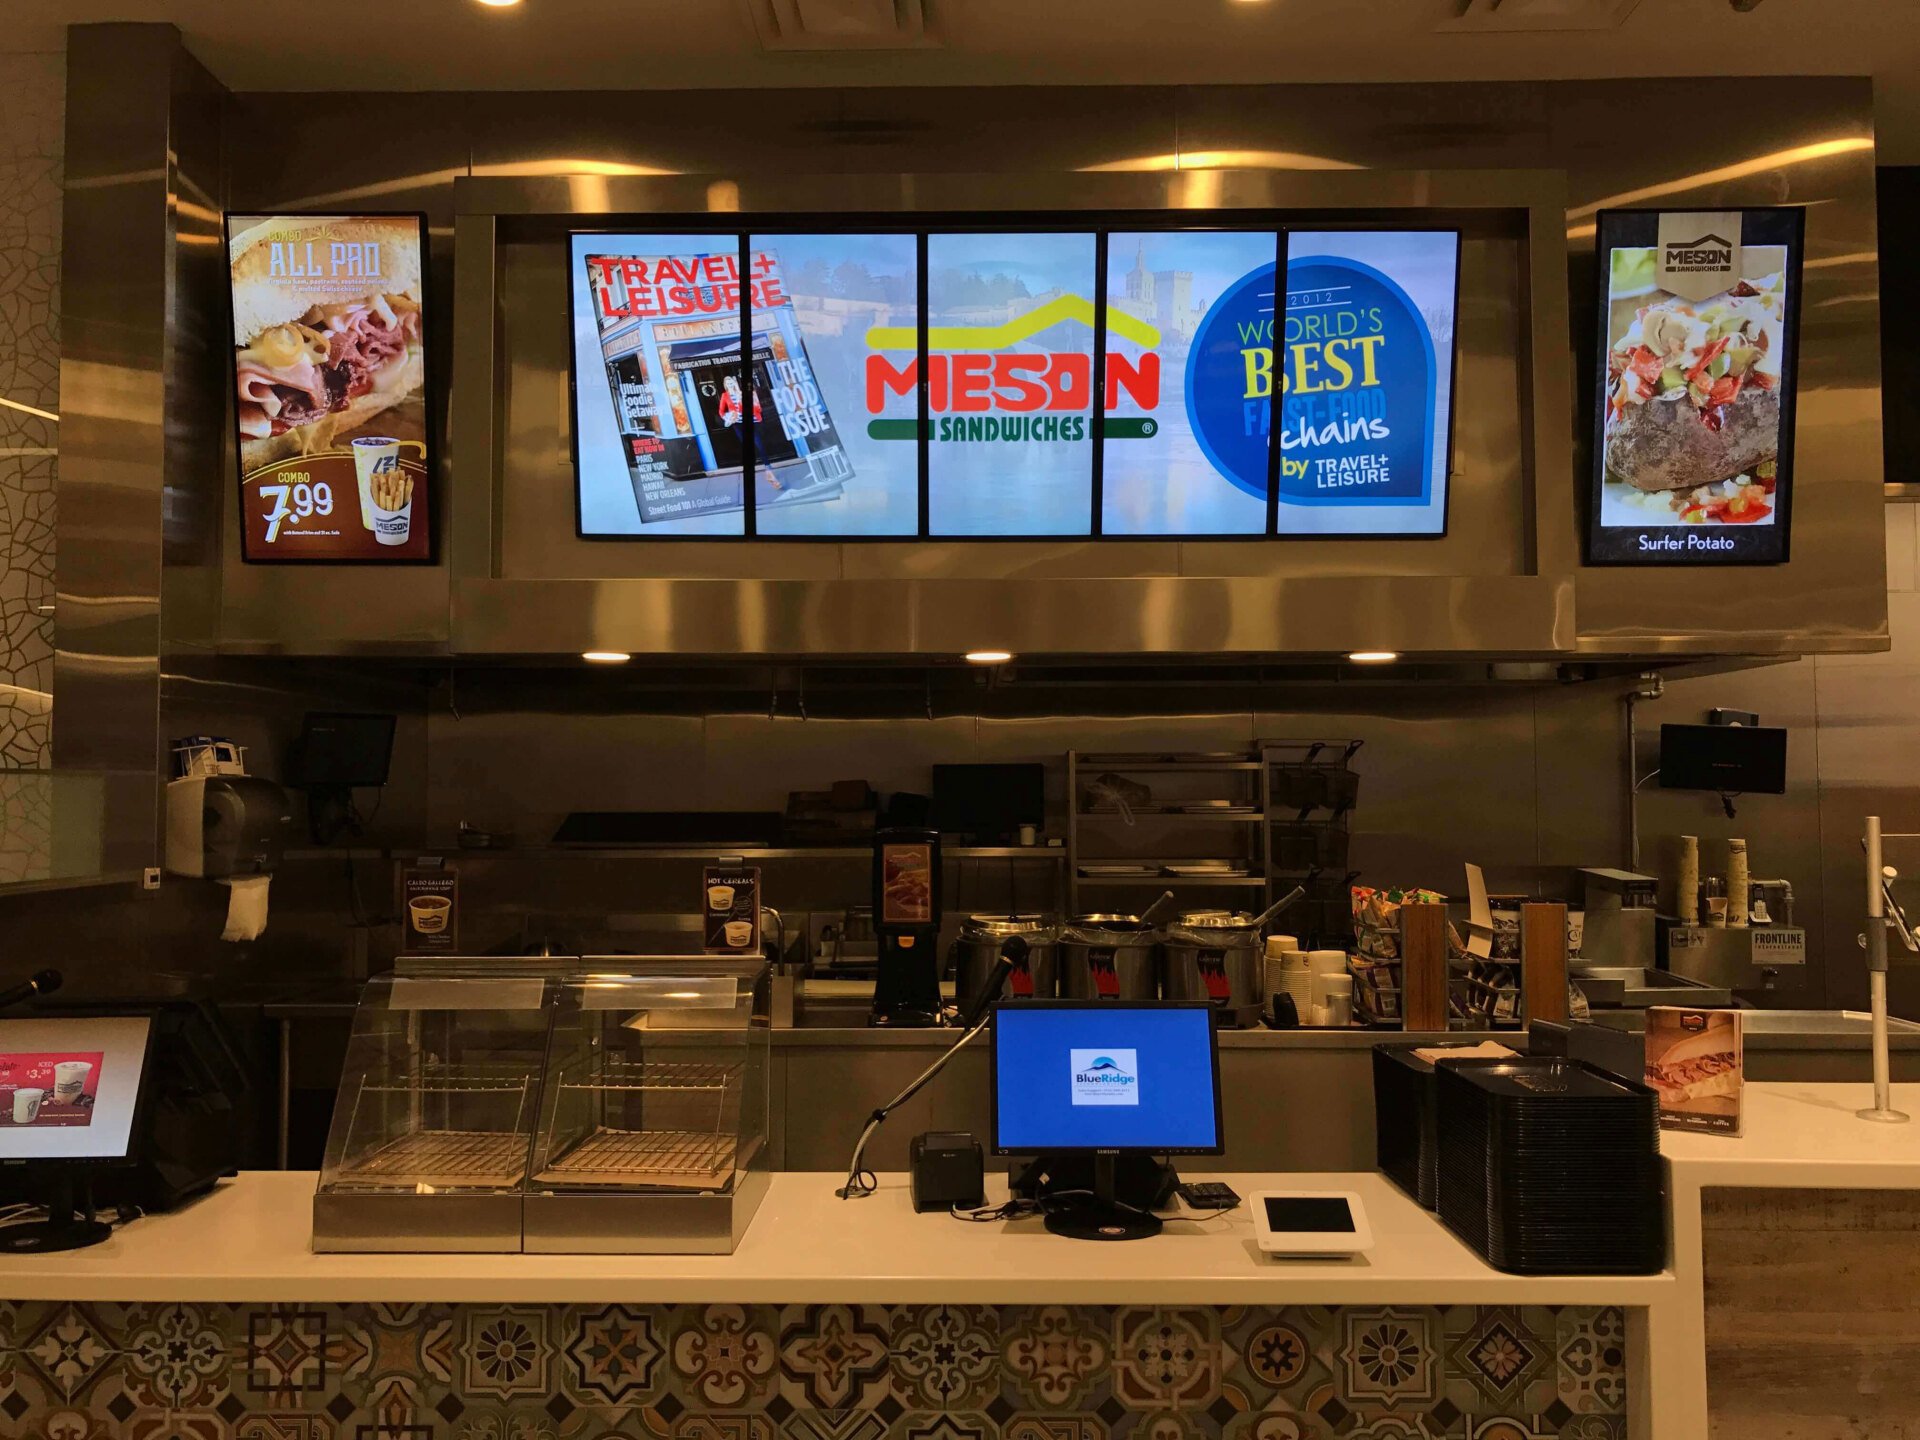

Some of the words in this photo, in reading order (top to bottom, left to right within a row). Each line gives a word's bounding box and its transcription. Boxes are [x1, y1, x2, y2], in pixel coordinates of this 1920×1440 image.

[270, 242, 323, 277] ALL
[592, 253, 776, 286] TRAVEL+
[1666, 249, 1732, 265] MESON
[1676, 265, 1720, 273] SANDWICHES
[600, 278, 787, 317] LEISURE
[1290, 292, 1333, 306] 2012
[1237, 307, 1383, 345] WORLD'S
[777, 357, 811, 386] THE
[1240, 335, 1385, 399] BEST
[866, 352, 1160, 415] MESON
[771, 380, 819, 415] FOOD
[779, 404, 831, 441] ISSUE
[940, 416, 1084, 442] SANDWICHES
[1267, 411, 1391, 450] chains
[277, 472, 311, 483] COMBO
[1281, 457, 1310, 479] by
[1315, 453, 1389, 474] TRAVEL+
[1316, 467, 1390, 488] LEISURE
[259, 482, 334, 543] 7.99
[648, 505, 667, 515] Street
[376, 521, 409, 531] MESON
[1638, 534, 1685, 550] Surfer
[1687, 534, 1735, 550] Potato
[1754, 933, 1802, 944] FRONTLINE
[1076, 1073, 1135, 1085] BlueRidge
